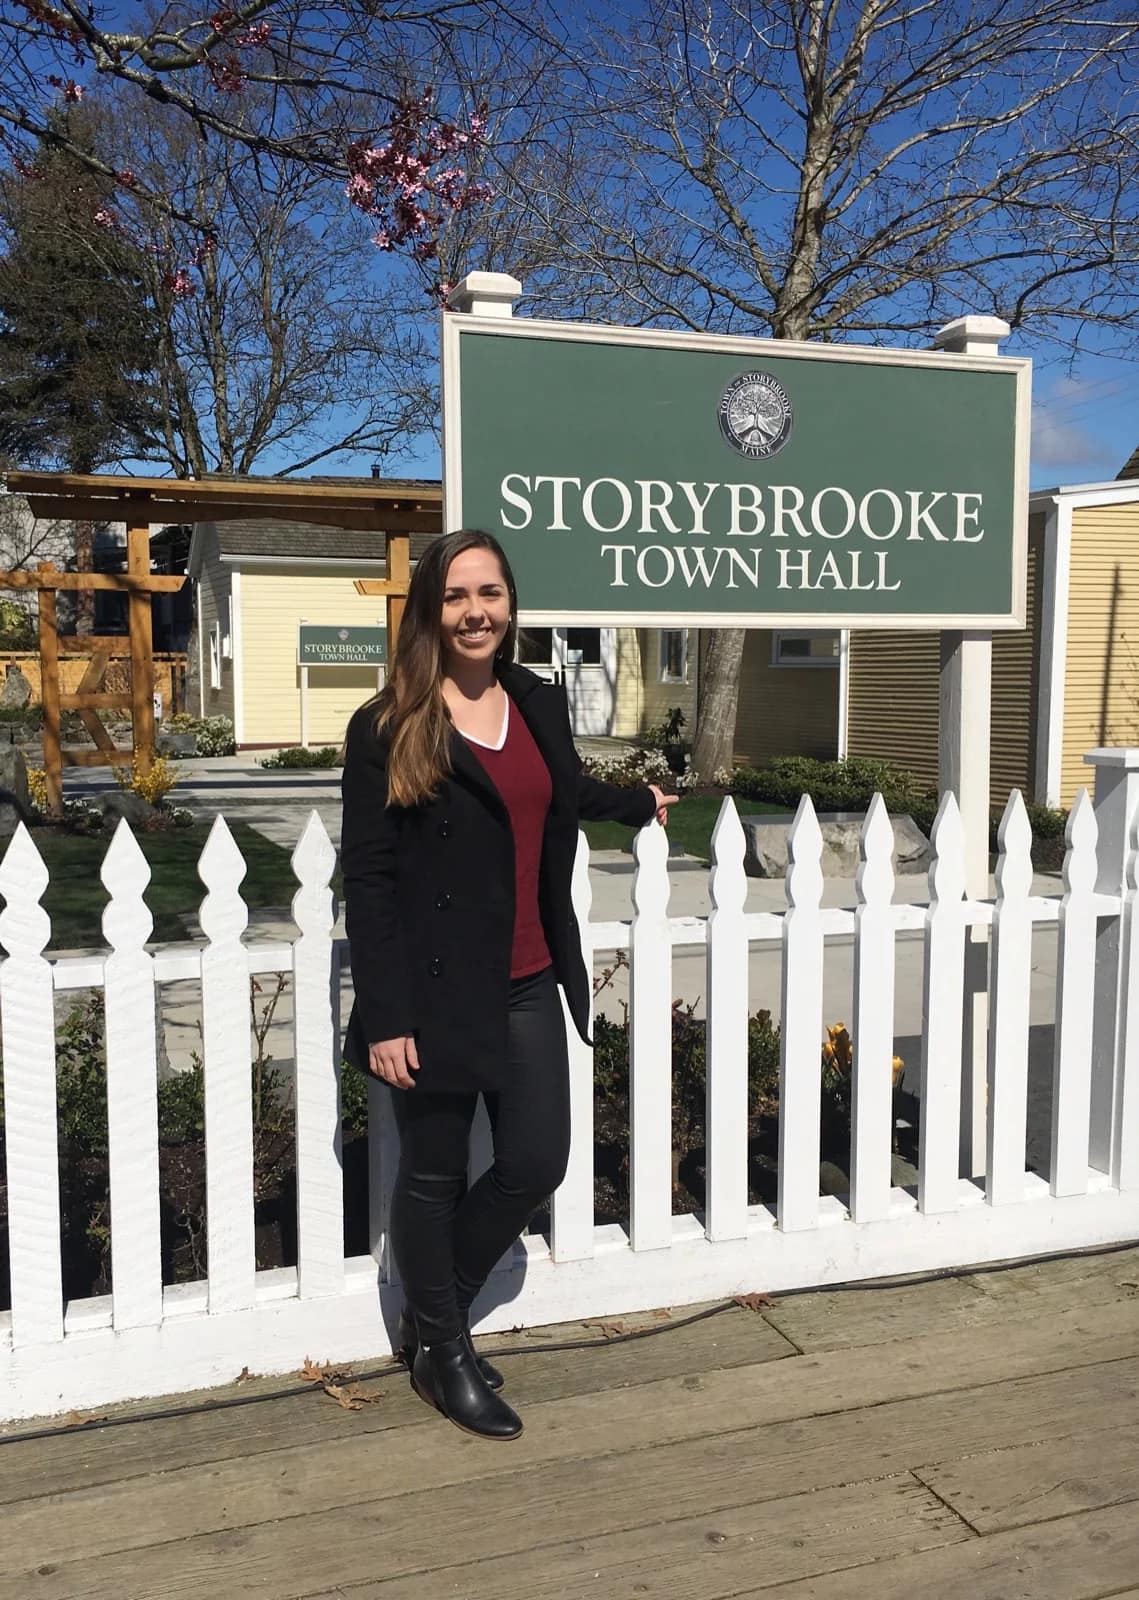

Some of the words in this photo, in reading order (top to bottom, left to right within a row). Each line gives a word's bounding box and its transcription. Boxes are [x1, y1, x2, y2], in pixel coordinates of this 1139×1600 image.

[720, 386, 735, 415] TOWN
[742, 374, 792, 416] STORYBROOKE
[742, 445, 772, 456] MAINE
[500, 473, 985, 543] STORYBROOKE
[600, 544, 763, 588] TOWN
[775, 548, 902, 591] HALL
[304, 643, 382, 654] STORYBROOKE
[320, 653, 345, 661] TOWN
[346, 653, 368, 661] HALL
